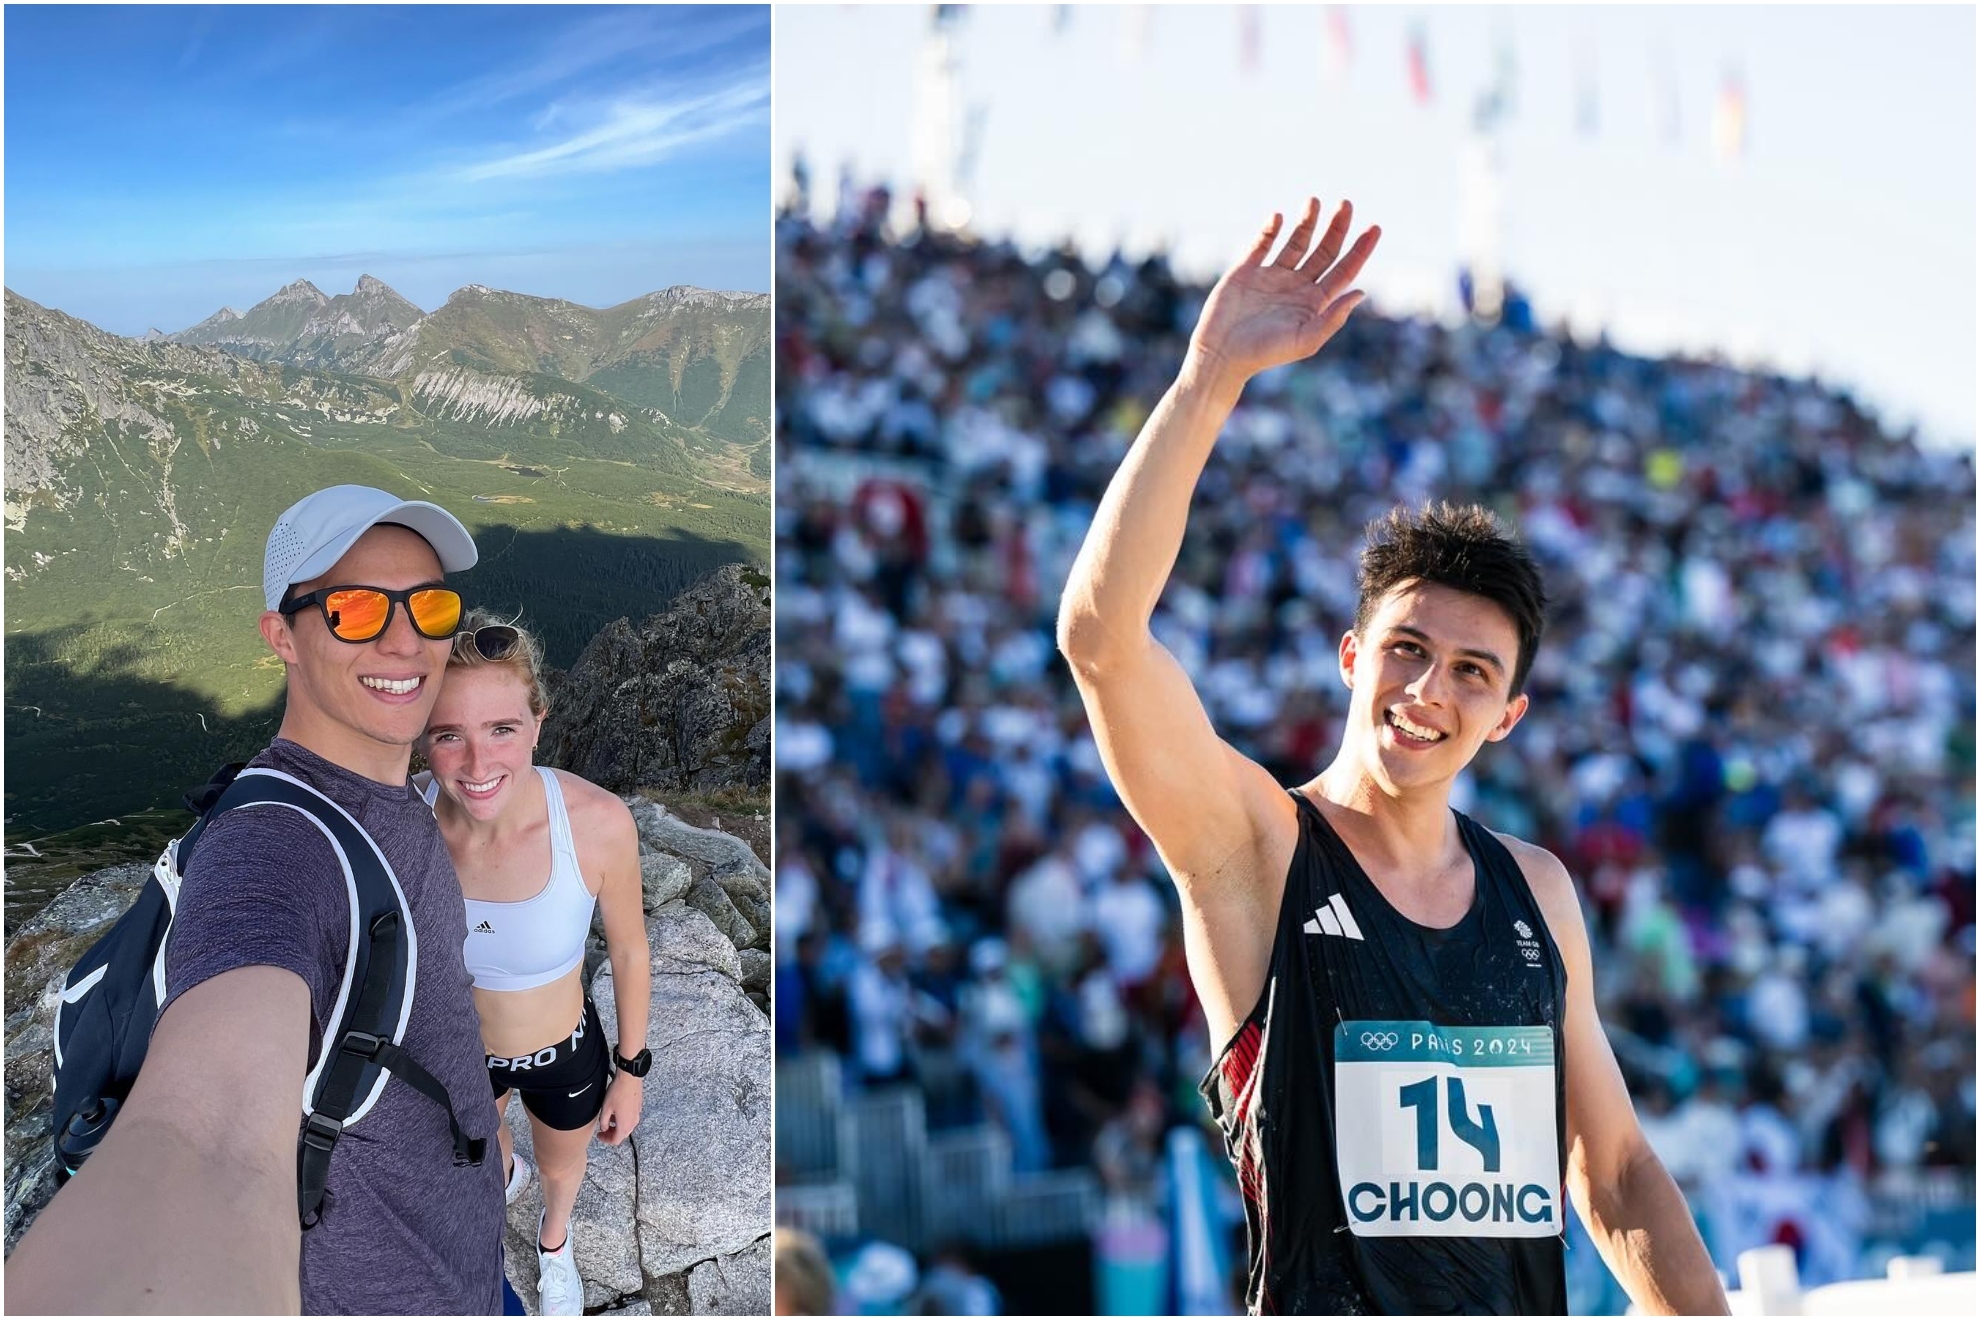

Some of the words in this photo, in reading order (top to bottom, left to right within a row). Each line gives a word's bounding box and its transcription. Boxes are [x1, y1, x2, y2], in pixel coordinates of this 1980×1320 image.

[487, 1046, 557, 1072] PRO
[1473, 1037, 1531, 1056] 2024
[1399, 1074, 1500, 1173] 14
[1348, 1181, 1553, 1223] CHOONG
